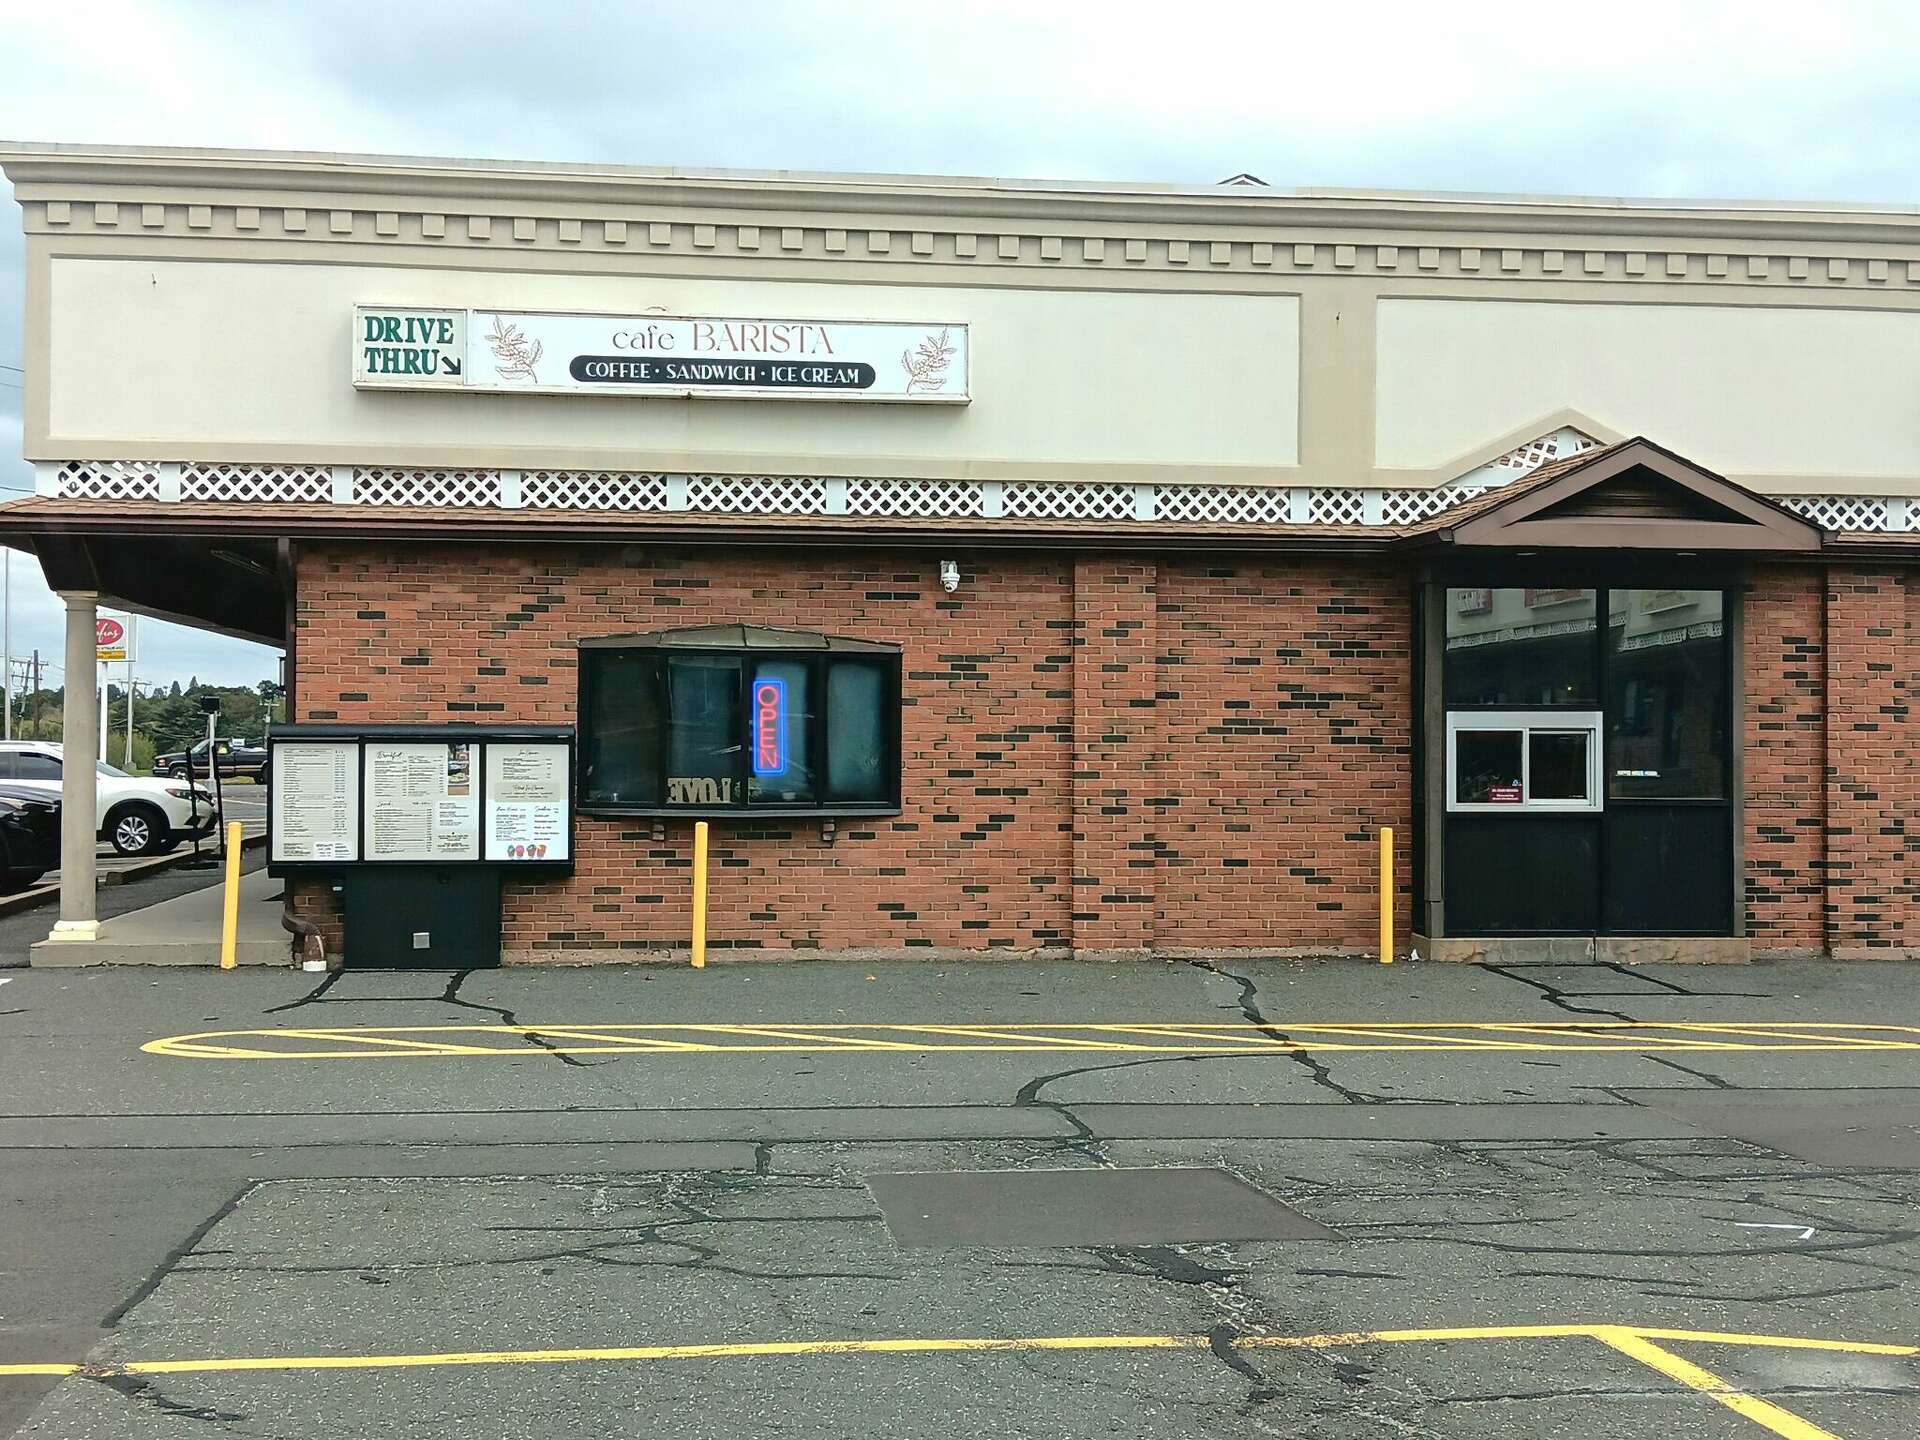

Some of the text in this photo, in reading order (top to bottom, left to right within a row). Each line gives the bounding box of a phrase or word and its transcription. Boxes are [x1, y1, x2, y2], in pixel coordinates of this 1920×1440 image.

[364, 316, 454, 344] DRIVE
[612, 322, 834, 354] cafe BARISTA
[364, 346, 440, 375] THRU
[585, 361, 859, 384] COFFEE SANDWICH ICE CREAM
[758, 685, 779, 769] OPEN
